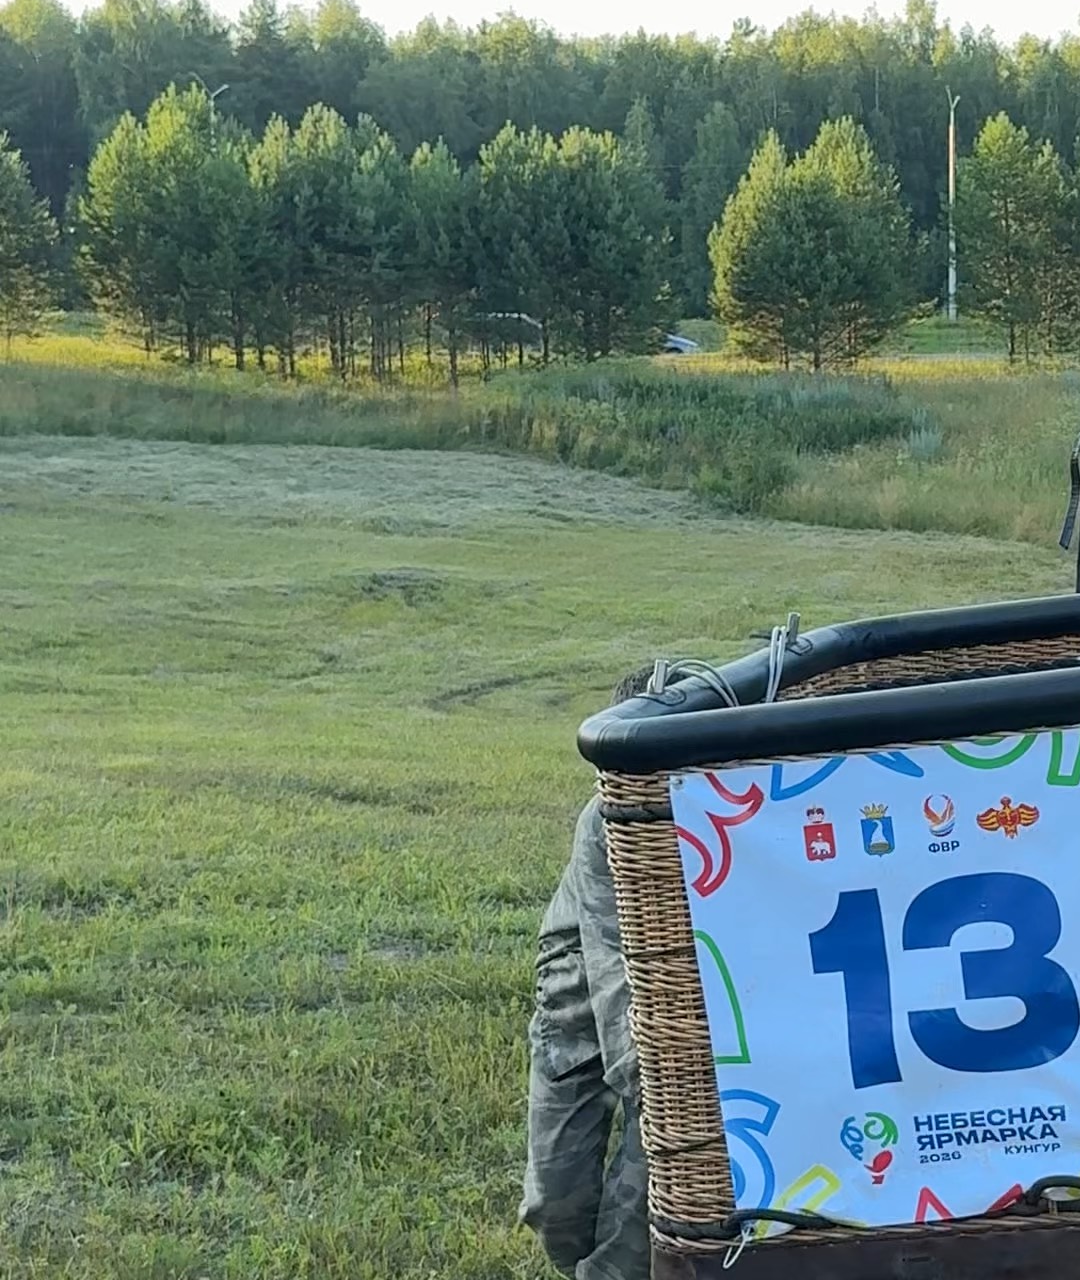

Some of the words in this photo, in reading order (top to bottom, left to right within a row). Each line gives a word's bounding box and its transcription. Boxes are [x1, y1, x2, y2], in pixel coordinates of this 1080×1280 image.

[928, 840, 960, 853] ФВР
[808, 871, 1080, 1090] 13
[913, 1104, 1067, 1133] НЕБЕСНАЯ
[917, 1122, 1059, 1151] ЯРМАРКА
[1004, 1142, 1061, 1155] КУНГУР
